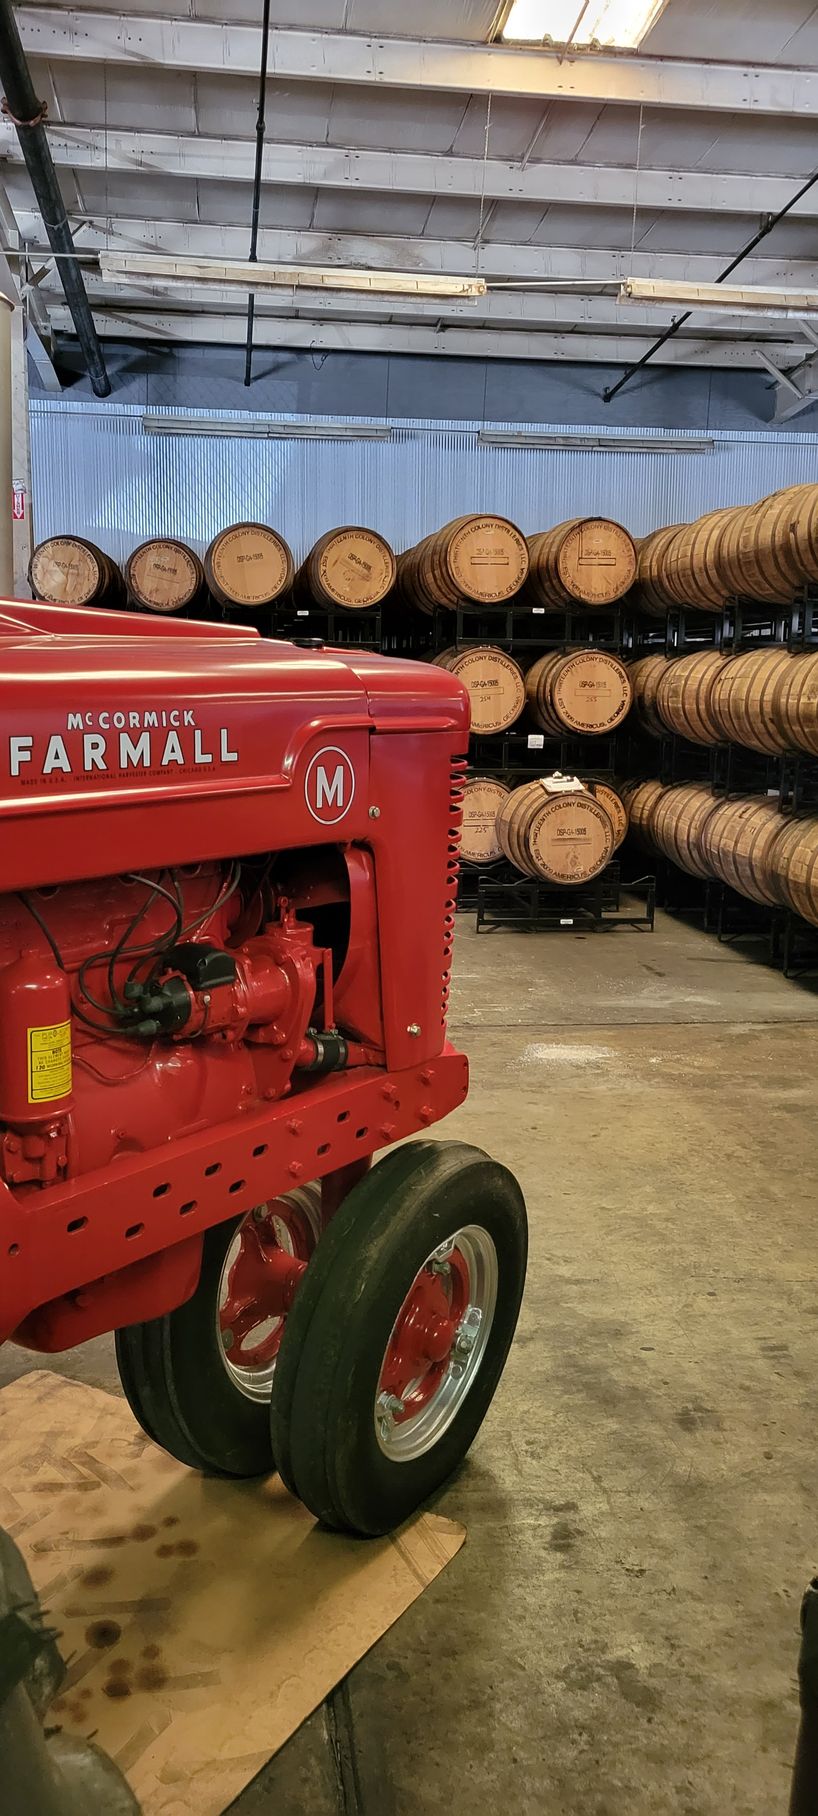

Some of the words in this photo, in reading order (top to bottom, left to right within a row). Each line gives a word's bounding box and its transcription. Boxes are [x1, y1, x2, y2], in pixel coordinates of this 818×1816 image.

[354, 534, 376, 544] COLONY
[470, 523, 494, 533] COLONY
[229, 530, 250, 542] COLONY
[250, 530, 282, 552] DISTILLERIES
[506, 567, 525, 592] GEORGIA
[465, 656, 487, 666] COLONY
[488, 655, 518, 679] DISTILLERIES
[575, 656, 599, 665] COLONY
[599, 657, 627, 684] DISTILLERIES
[558, 698, 566, 709] EST
[607, 700, 626, 724] GEORGIA
[9, 728, 239, 777] FARMALL
[73, 772, 117, 783] INTERNATIONAL
[118, 769, 147, 779] HARVESTER
[149, 767, 174, 777] COMPANY
[316, 765, 345, 809] M
[550, 801, 576, 813] COLONY
[576, 801, 609, 828] DISTILLERIES
[534, 848, 543, 860] EST
[589, 846, 609, 874] GEORGIA
